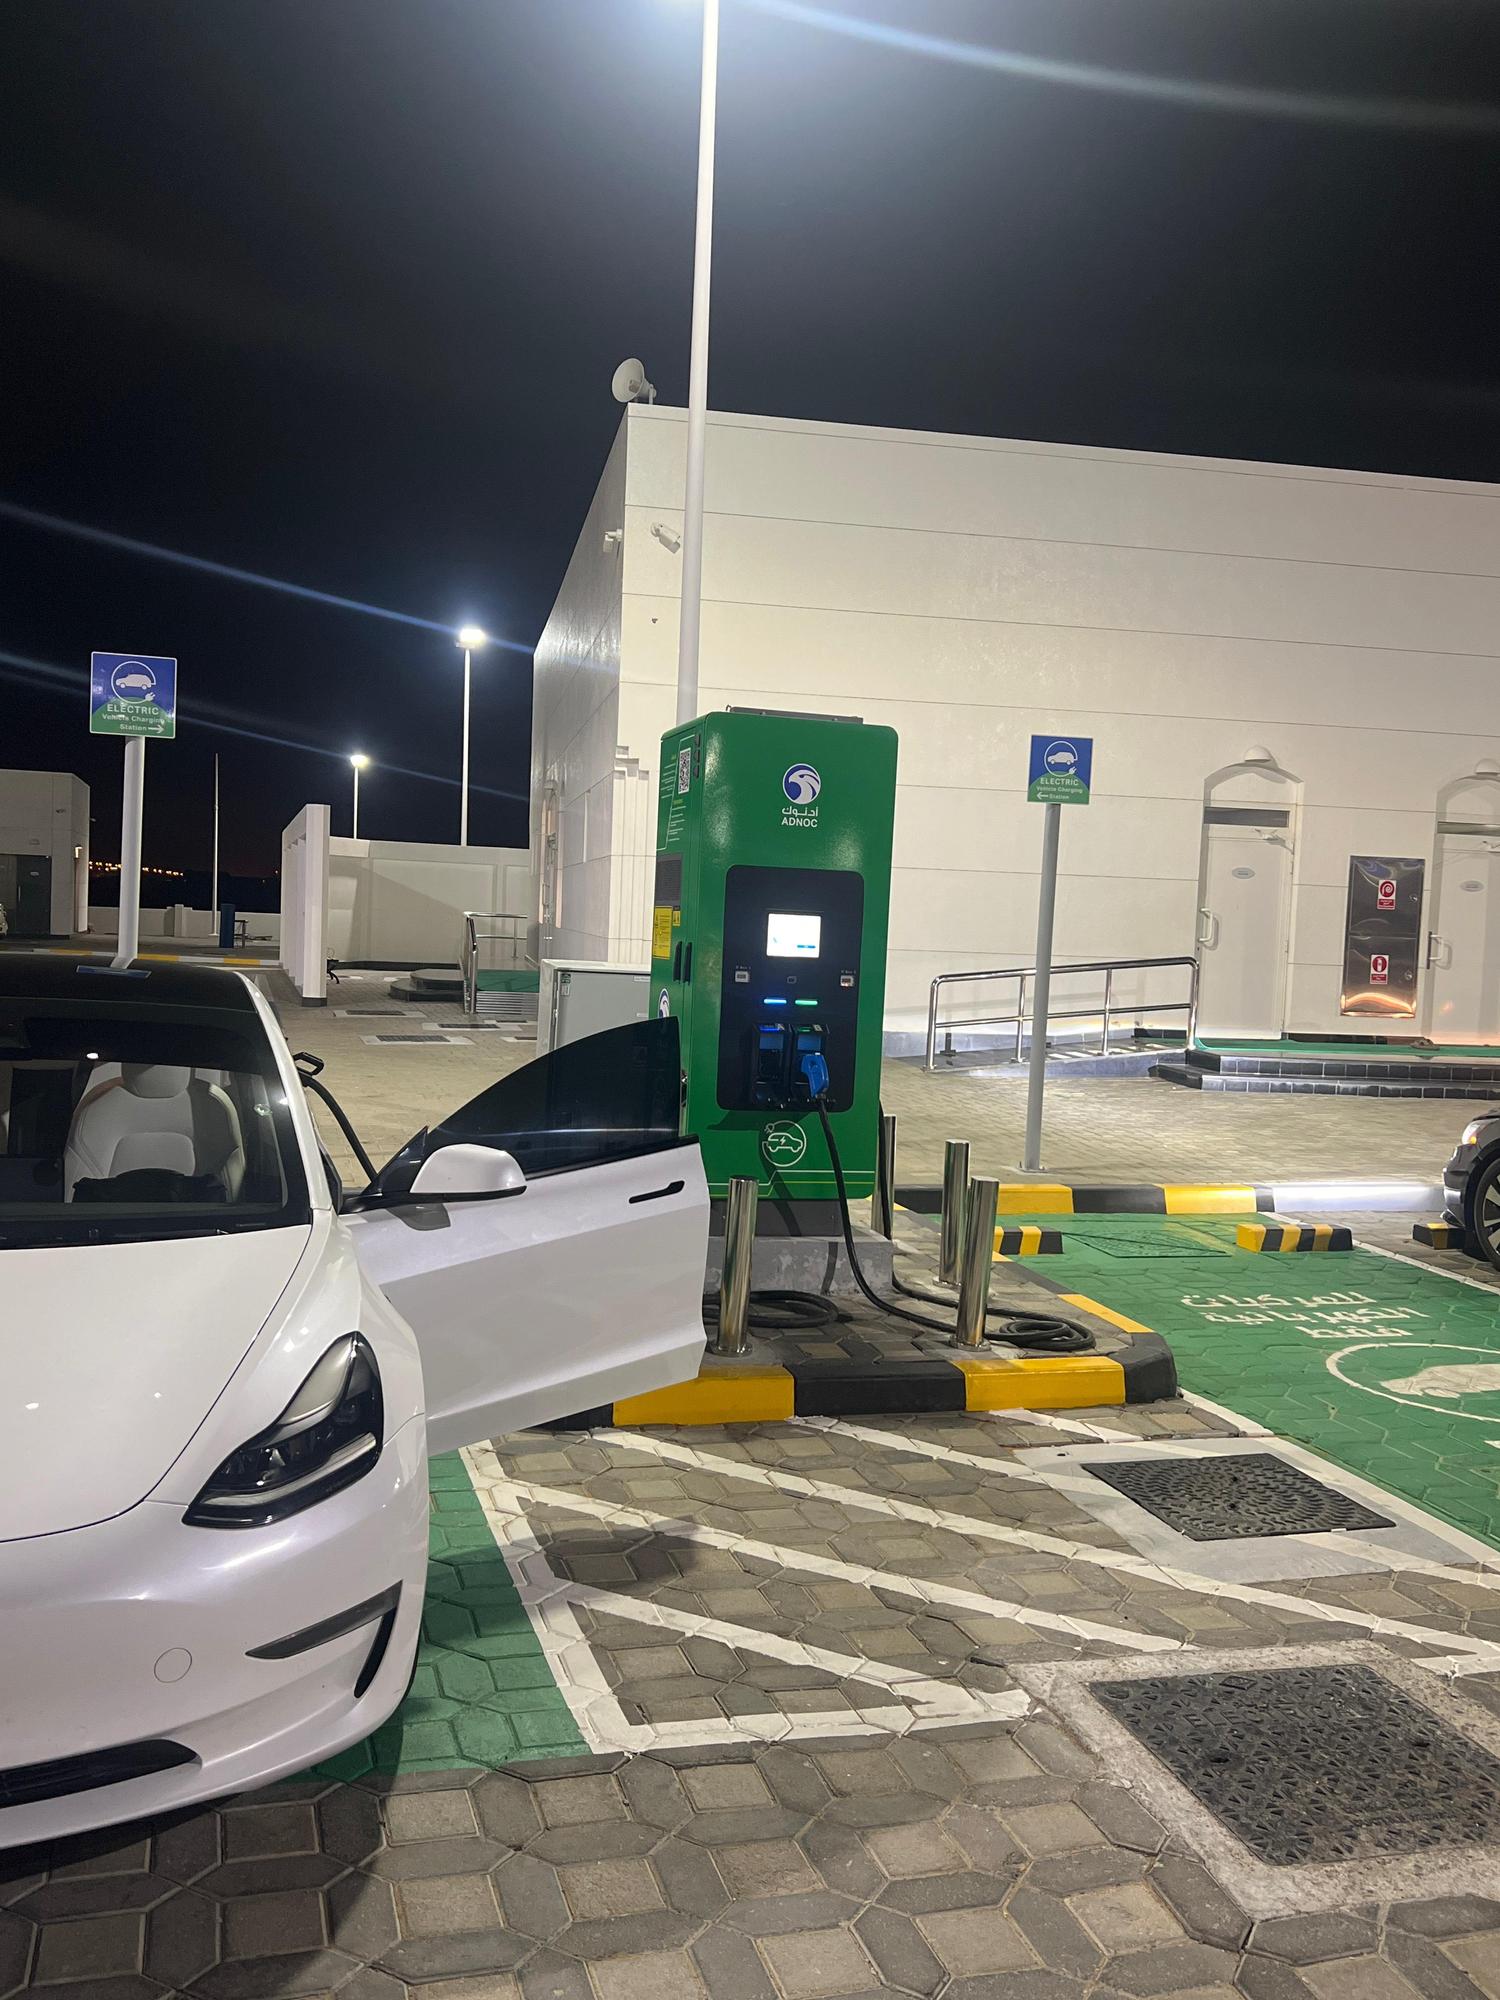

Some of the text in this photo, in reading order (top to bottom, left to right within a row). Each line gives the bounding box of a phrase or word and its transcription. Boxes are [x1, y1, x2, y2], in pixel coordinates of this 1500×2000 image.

[106, 703, 159, 715] ELECTRIC
[102, 713, 165, 725] Vehicle Charging
[120, 723, 147, 731] Station
[1040, 777, 1079, 786] ELECTRIC
[781, 805, 819, 817] أدنوك
[781, 816, 818, 828] ADNOC
[1180, 1291, 1378, 1308] للمركبات
[1295, 1325, 1414, 1338] فقط
